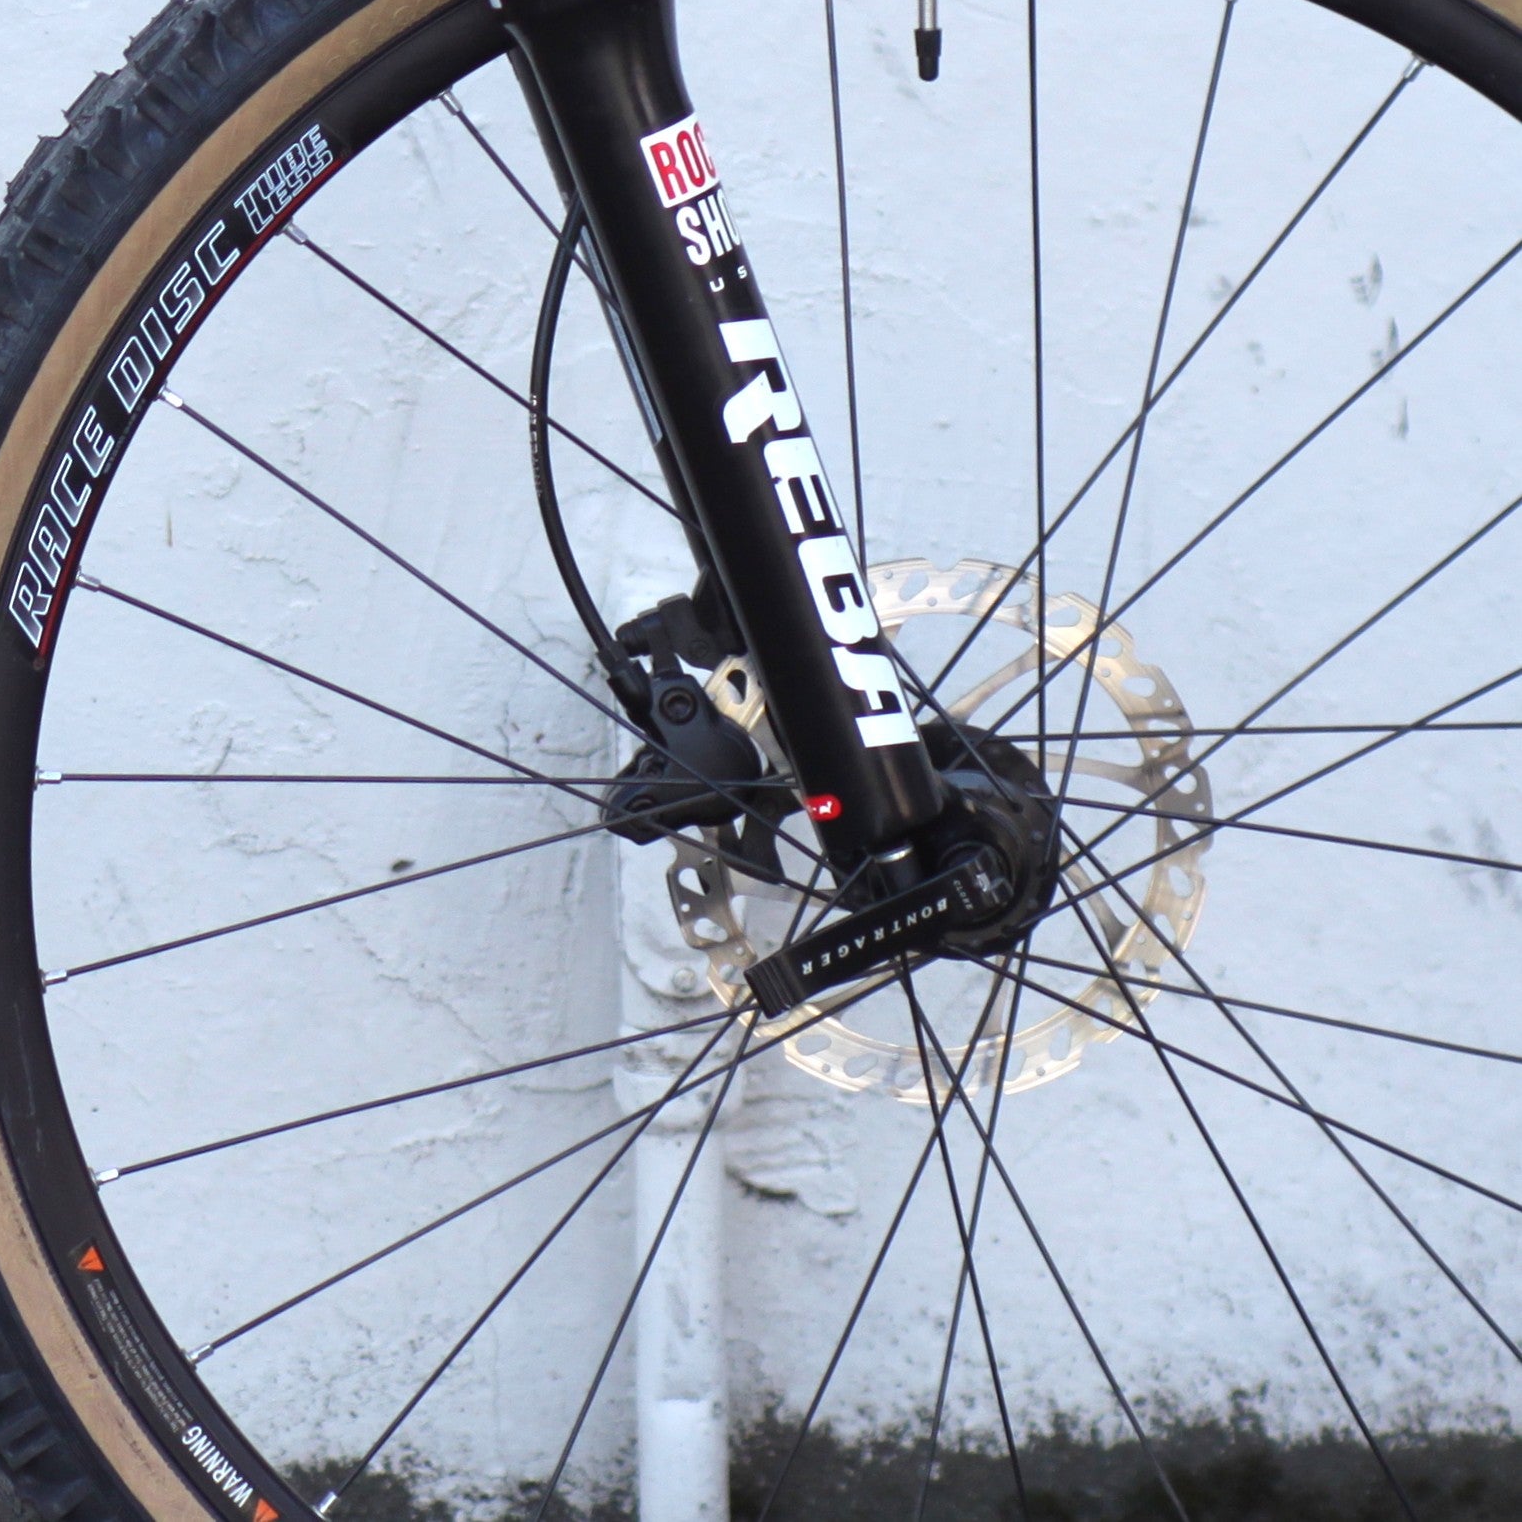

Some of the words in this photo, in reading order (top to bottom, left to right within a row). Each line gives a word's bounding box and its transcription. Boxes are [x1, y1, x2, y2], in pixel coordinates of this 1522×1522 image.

[650, 121, 717, 200] ROC
[675, 188, 741, 266] SHO
[9, 405, 114, 648] RACE
[107, 219, 241, 414] DISC
[718, 318, 920, 749] REBA
[802, 897, 949, 976] BONTRAGER
[181, 1425, 254, 1508] WARNING
